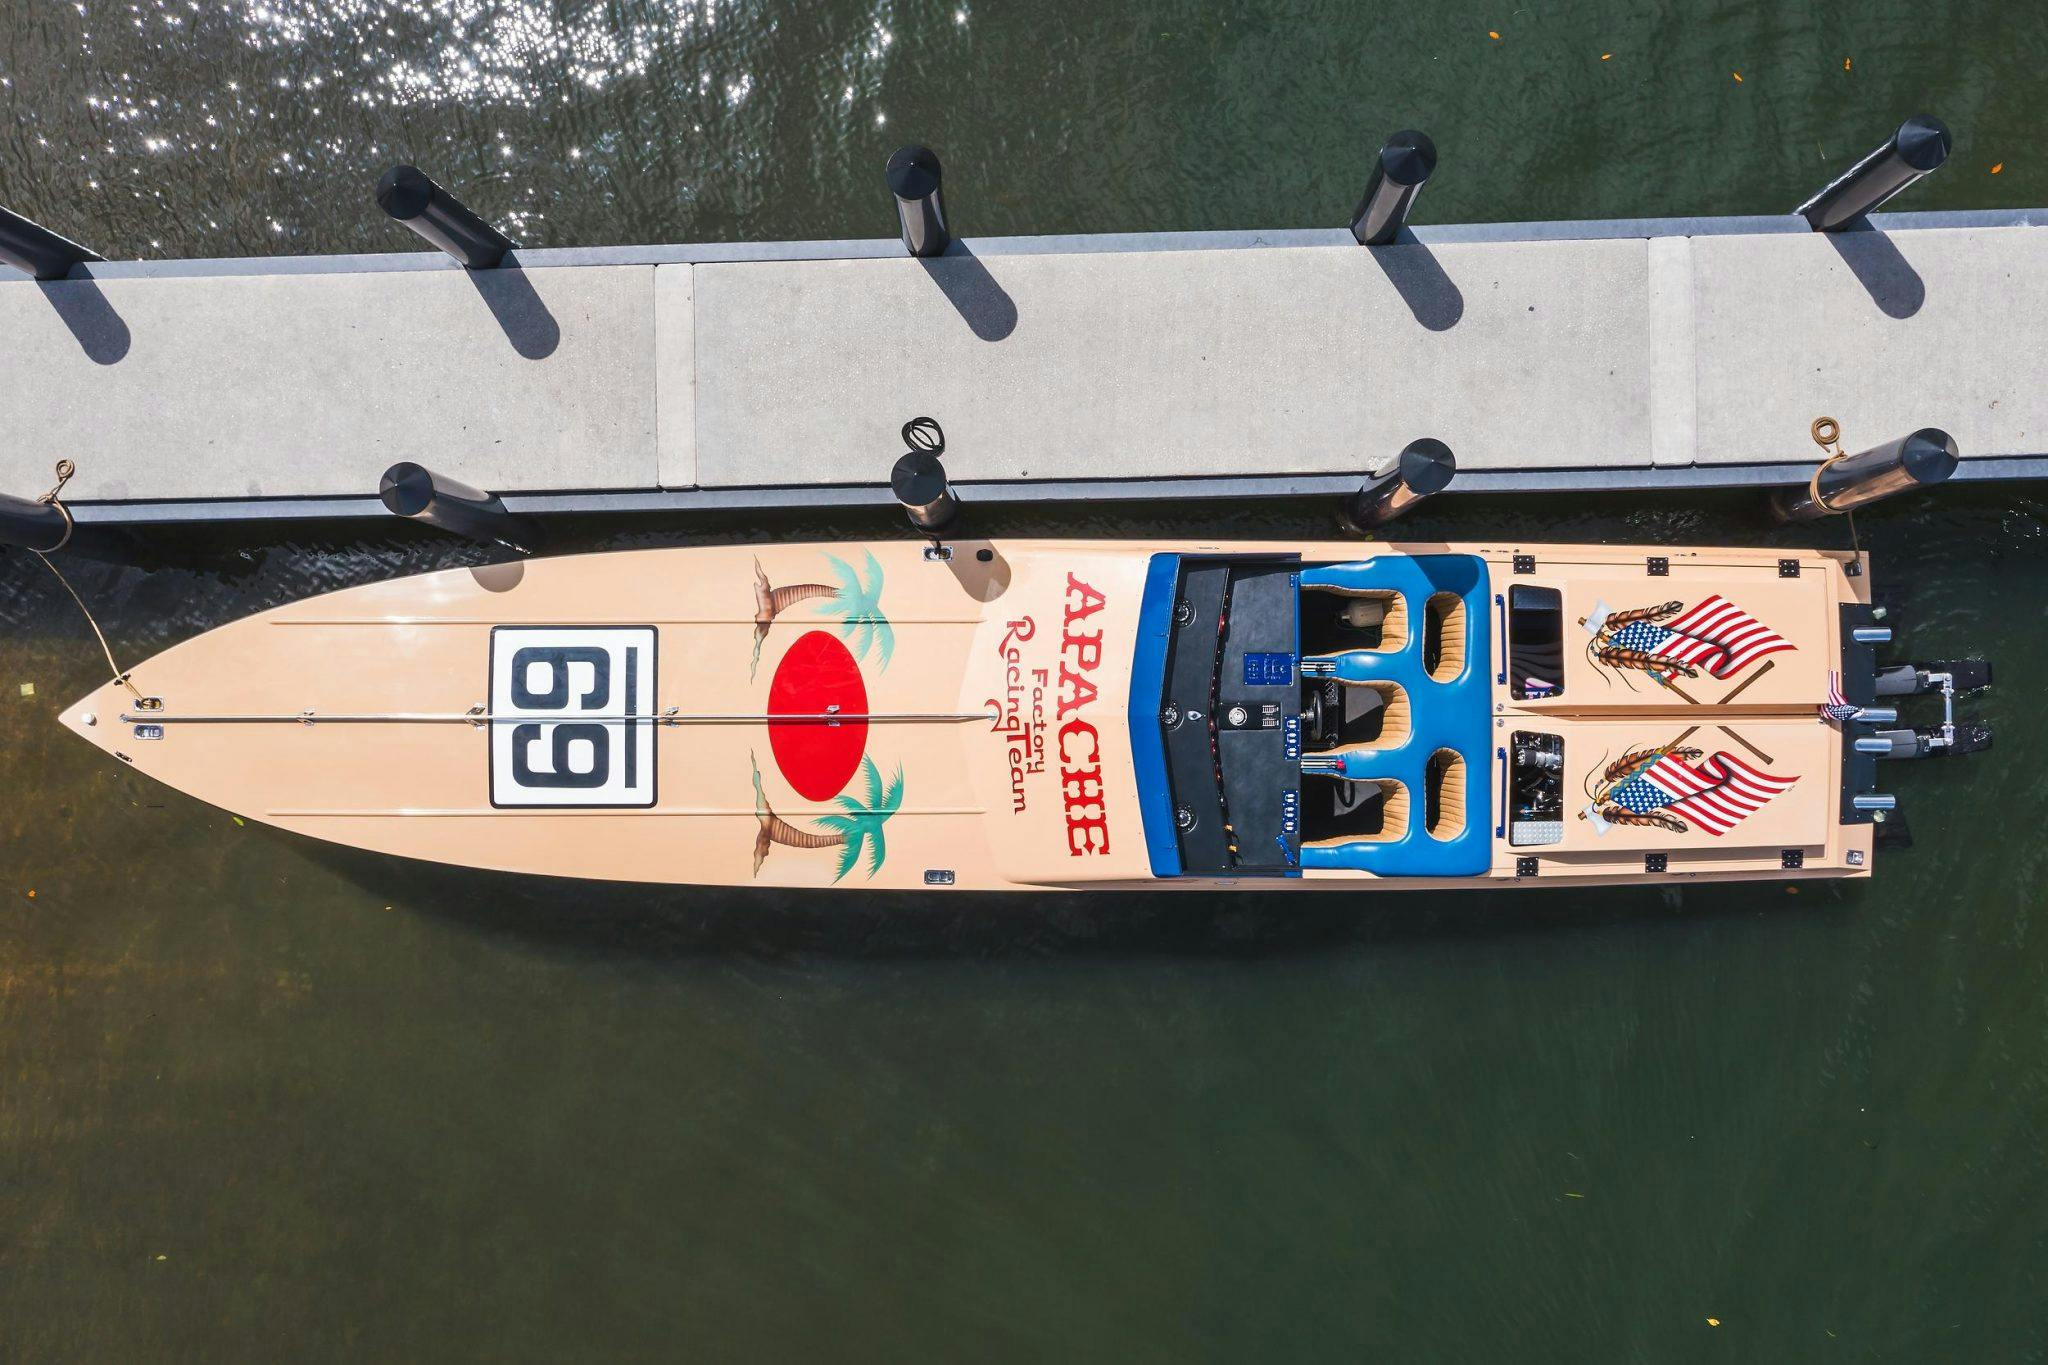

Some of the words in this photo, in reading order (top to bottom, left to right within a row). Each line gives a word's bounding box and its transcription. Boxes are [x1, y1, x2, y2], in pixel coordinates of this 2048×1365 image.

[511, 646, 610, 788] 69
[985, 615, 1036, 733] Racing
[1027, 668, 1048, 773] Factory
[1057, 572, 1110, 856] APACHE
[1006, 722, 1032, 815] Team
